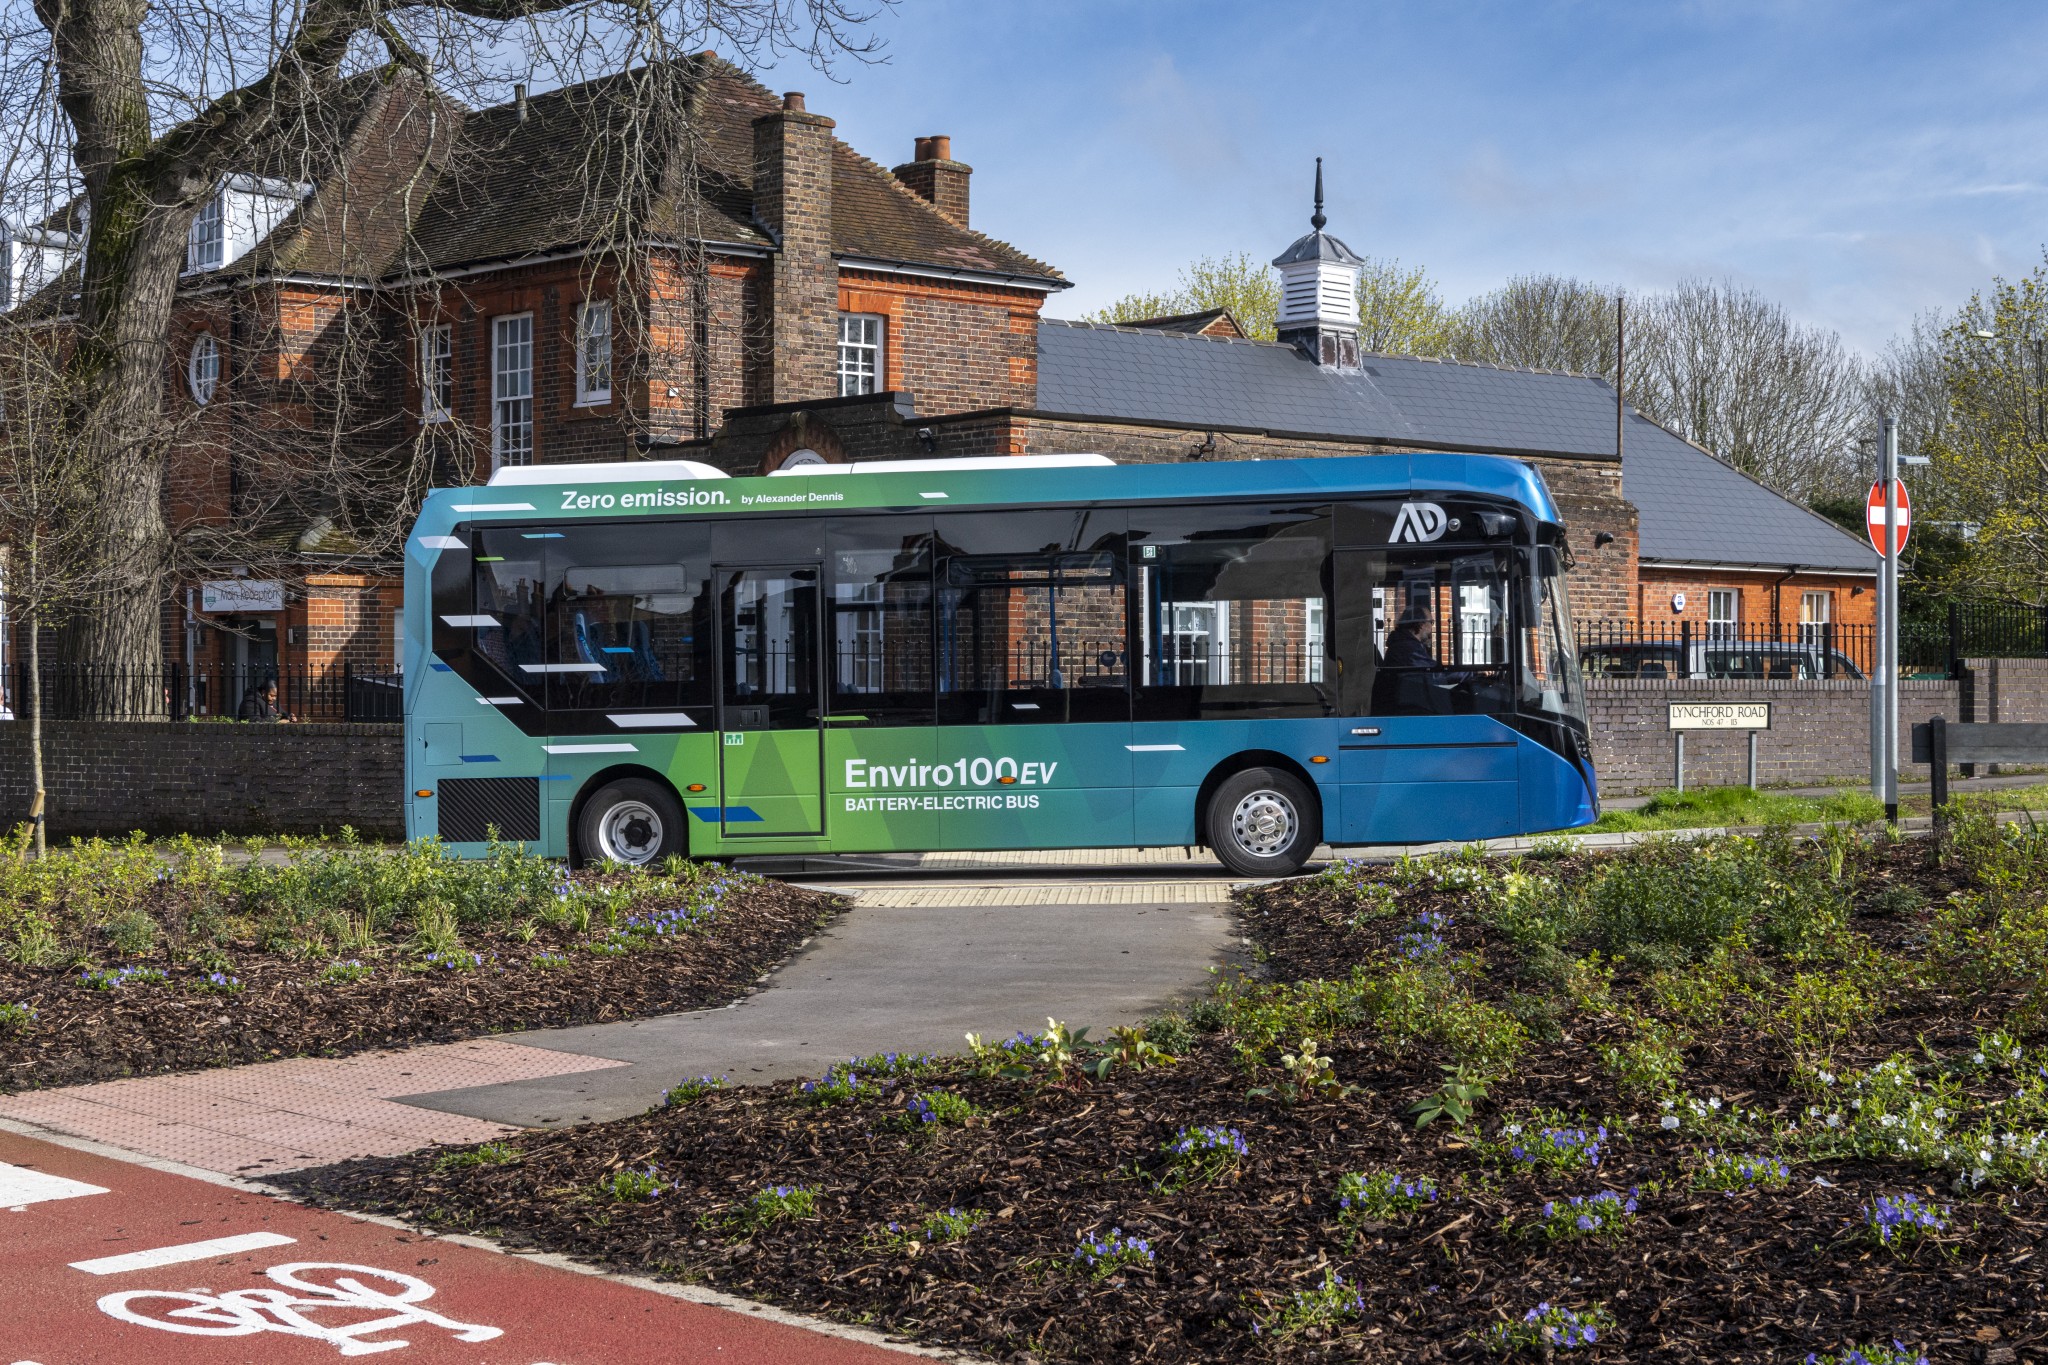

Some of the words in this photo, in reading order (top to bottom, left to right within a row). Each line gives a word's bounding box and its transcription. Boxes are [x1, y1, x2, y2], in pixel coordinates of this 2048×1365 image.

[561, 490, 615, 510] Zero
[620, 487, 731, 508] emission.
[741, 495, 753, 505] by
[755, 493, 806, 504] Alexander
[808, 491, 844, 502] Dennis
[221, 588, 238, 601] Main
[241, 587, 278, 603] Reception
[1672, 706, 1734, 718] LYNCHFORD
[1738, 706, 1766, 718] ROAD
[845, 795, 1003, 812] BATTERY-ELECTRIC
[1006, 794, 1040, 810] BUS
